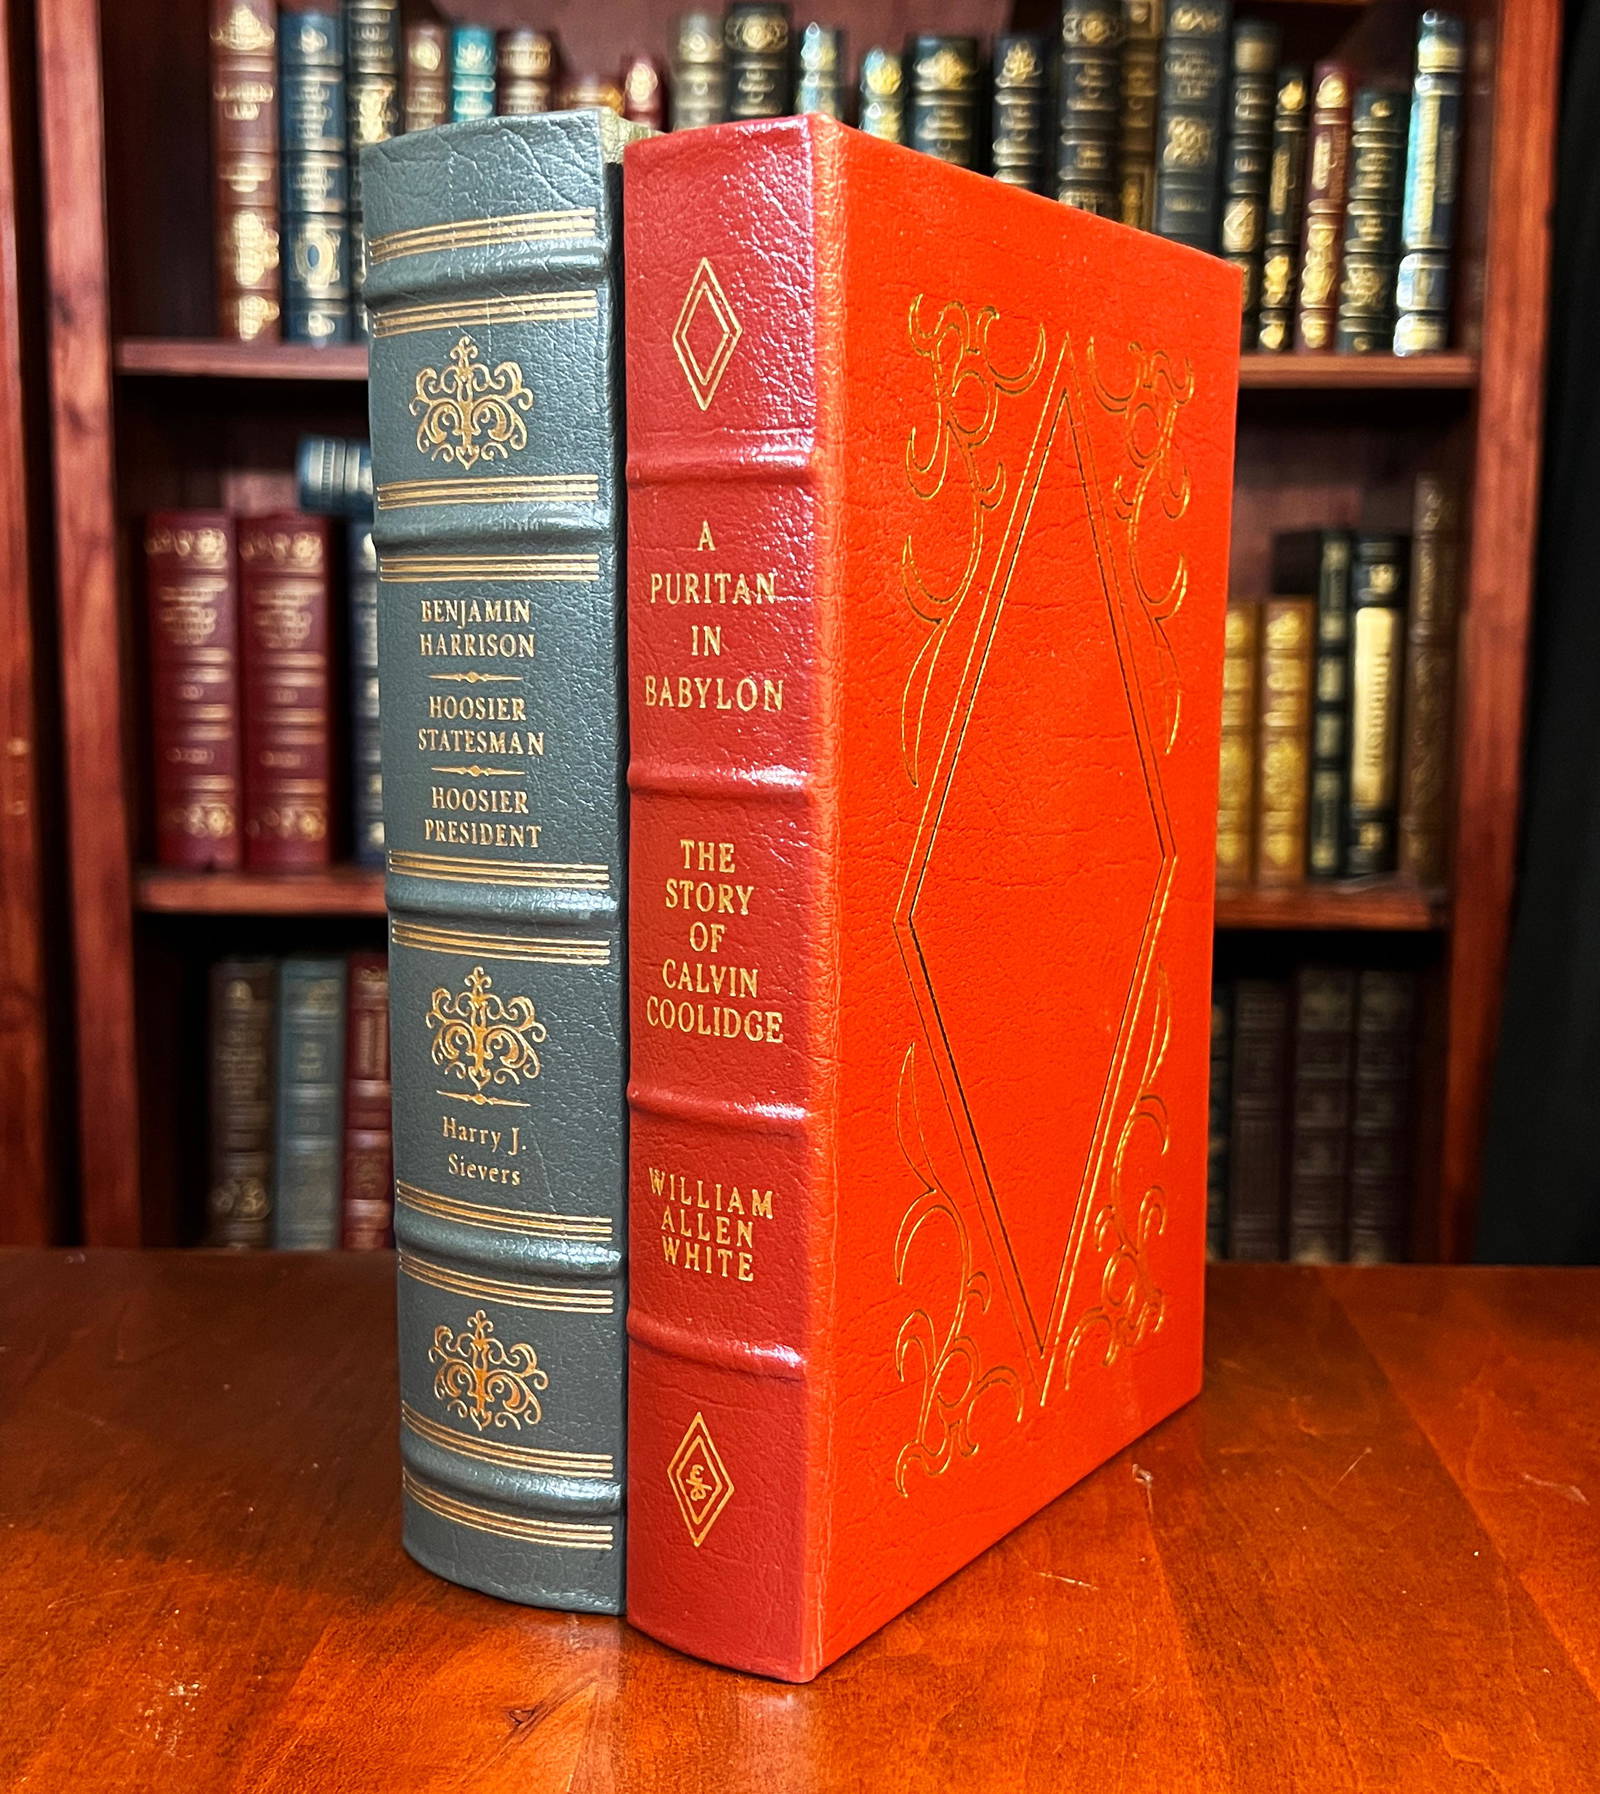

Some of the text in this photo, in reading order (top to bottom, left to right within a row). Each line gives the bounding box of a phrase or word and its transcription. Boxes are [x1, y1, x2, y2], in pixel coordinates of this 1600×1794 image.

[697, 519, 716, 551] A
[650, 572, 775, 605] PURITAN
[421, 599, 531, 629] BENJAMIN
[420, 633, 536, 658] HARRISON
[691, 625, 721, 656] IN
[429, 696, 527, 721] HOOSIER
[644, 674, 784, 712] BABYLON
[418, 728, 545, 756] STATESMAN
[431, 786, 530, 814] HOOSIER
[424, 819, 542, 848] PRESIDENT
[680, 839, 735, 873] THE
[665, 878, 754, 915] STORY
[689, 921, 726, 953] OF
[662, 959, 758, 998] CALVIN
[646, 996, 784, 1043] COOLIDGE
[442, 1115, 527, 1156] Harry J.
[448, 1152, 521, 1186] Sievers
[648, 1167, 773, 1219] WILLIAM
[660, 1205, 753, 1248] ALLEN
[661, 1235, 754, 1282] WHITE
